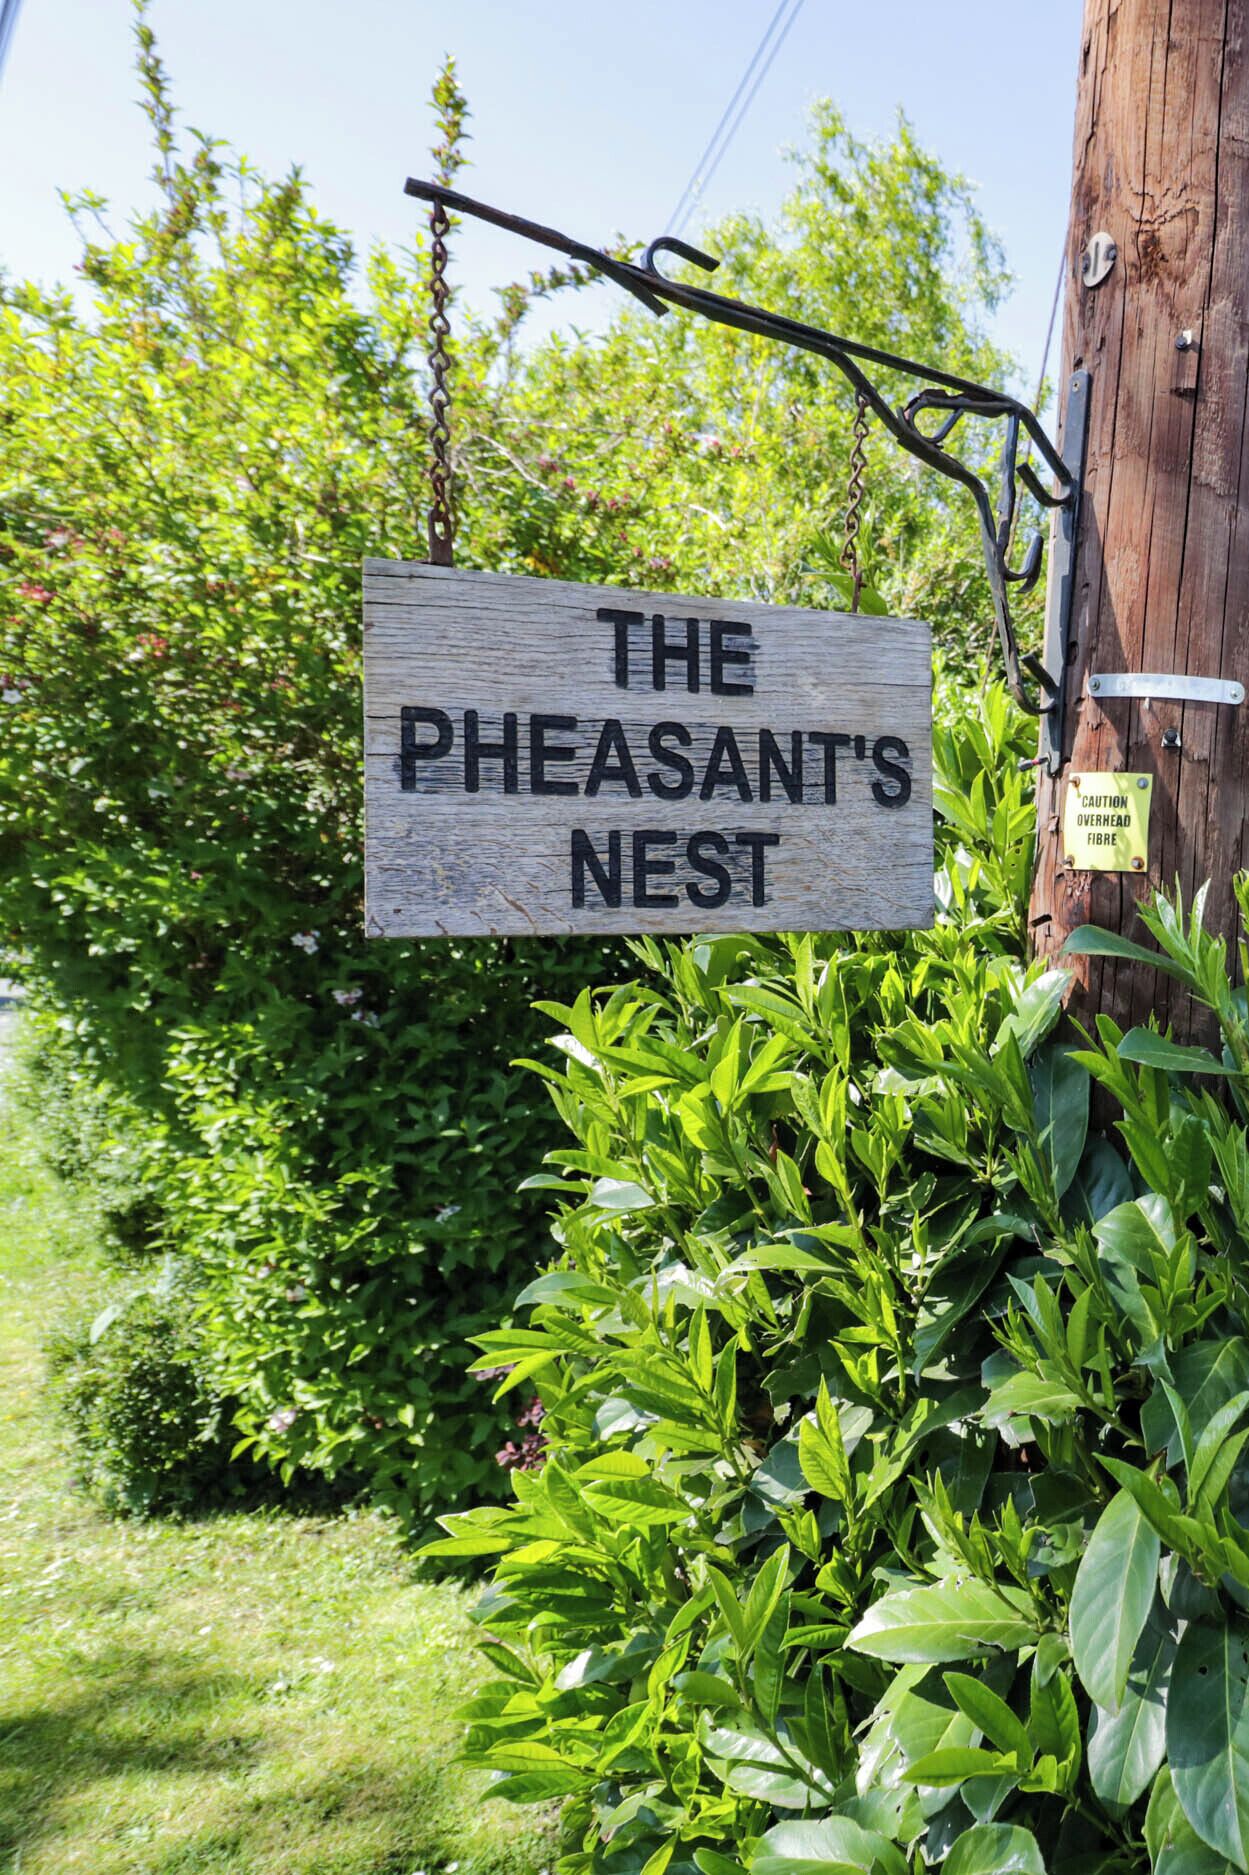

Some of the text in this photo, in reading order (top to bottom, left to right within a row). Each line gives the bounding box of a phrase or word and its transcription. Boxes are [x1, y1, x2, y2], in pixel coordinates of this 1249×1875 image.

[596, 608, 756, 696] THE
[399, 706, 912, 808] PHEASANT'S
[1077, 813, 1131, 828] OVERHEAD
[1081, 795, 1129, 809] CAUTION
[1087, 832, 1117, 846] FIBRE
[571, 829, 780, 909] NEST
